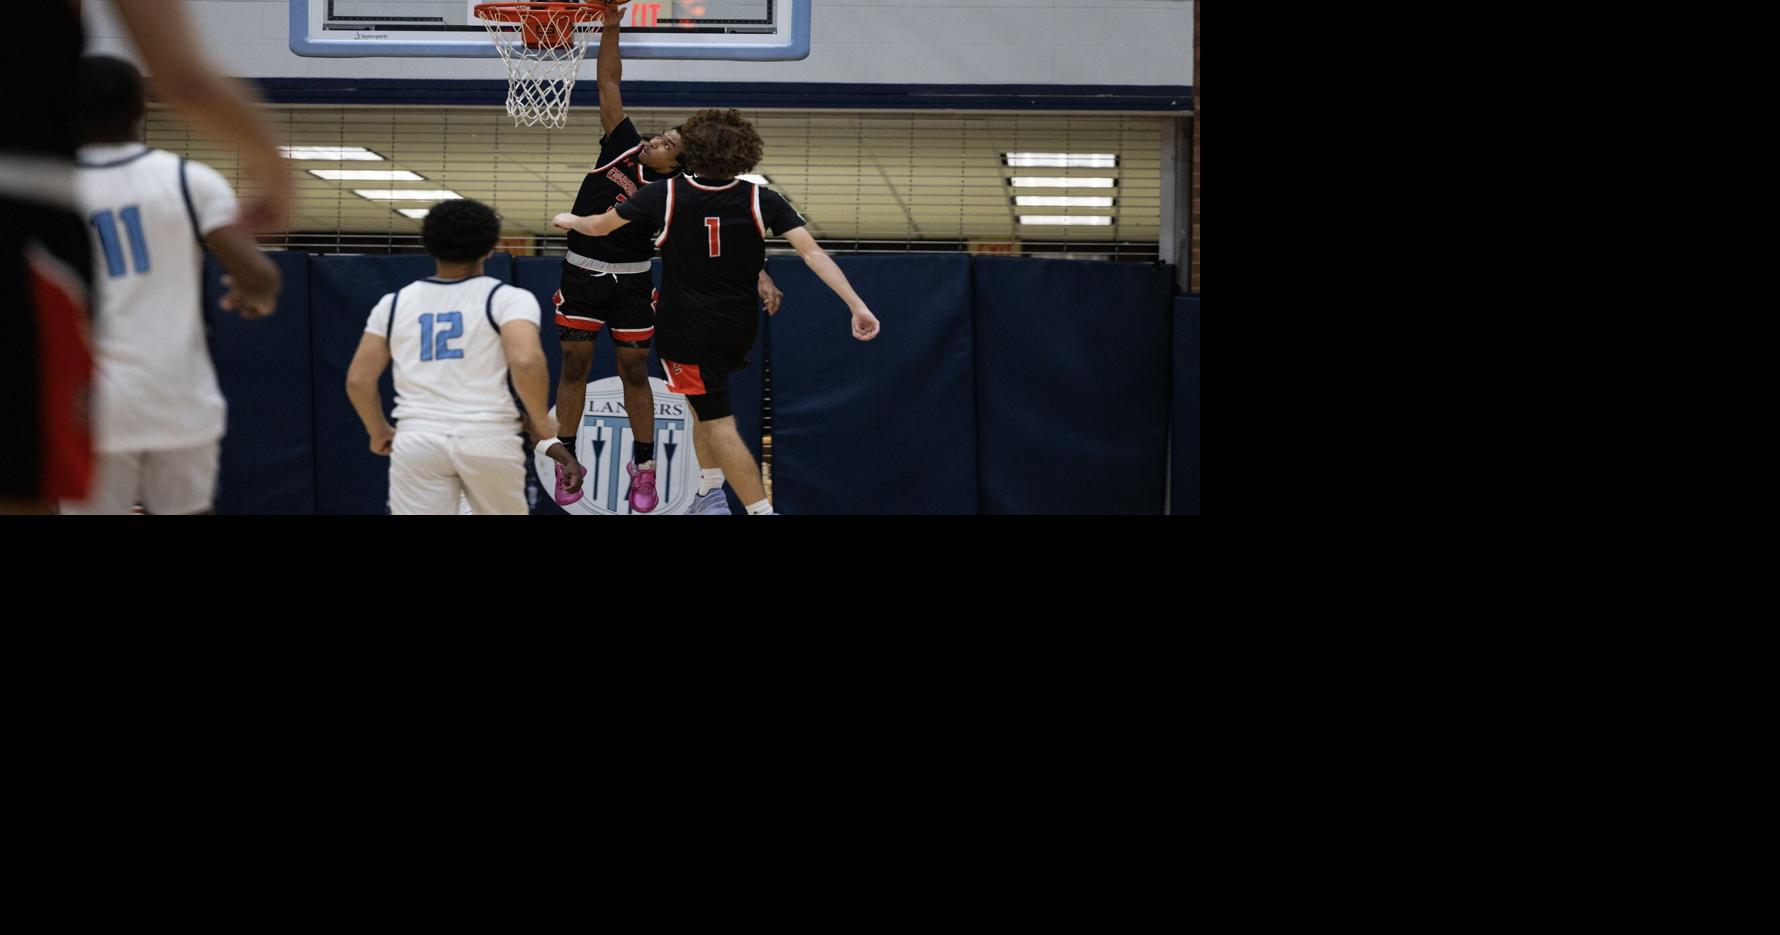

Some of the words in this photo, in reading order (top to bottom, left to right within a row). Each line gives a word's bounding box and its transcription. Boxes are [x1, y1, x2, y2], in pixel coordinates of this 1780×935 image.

[91, 206, 150, 276] 11
[704, 216, 721, 258] 1
[418, 311, 464, 361] 12
